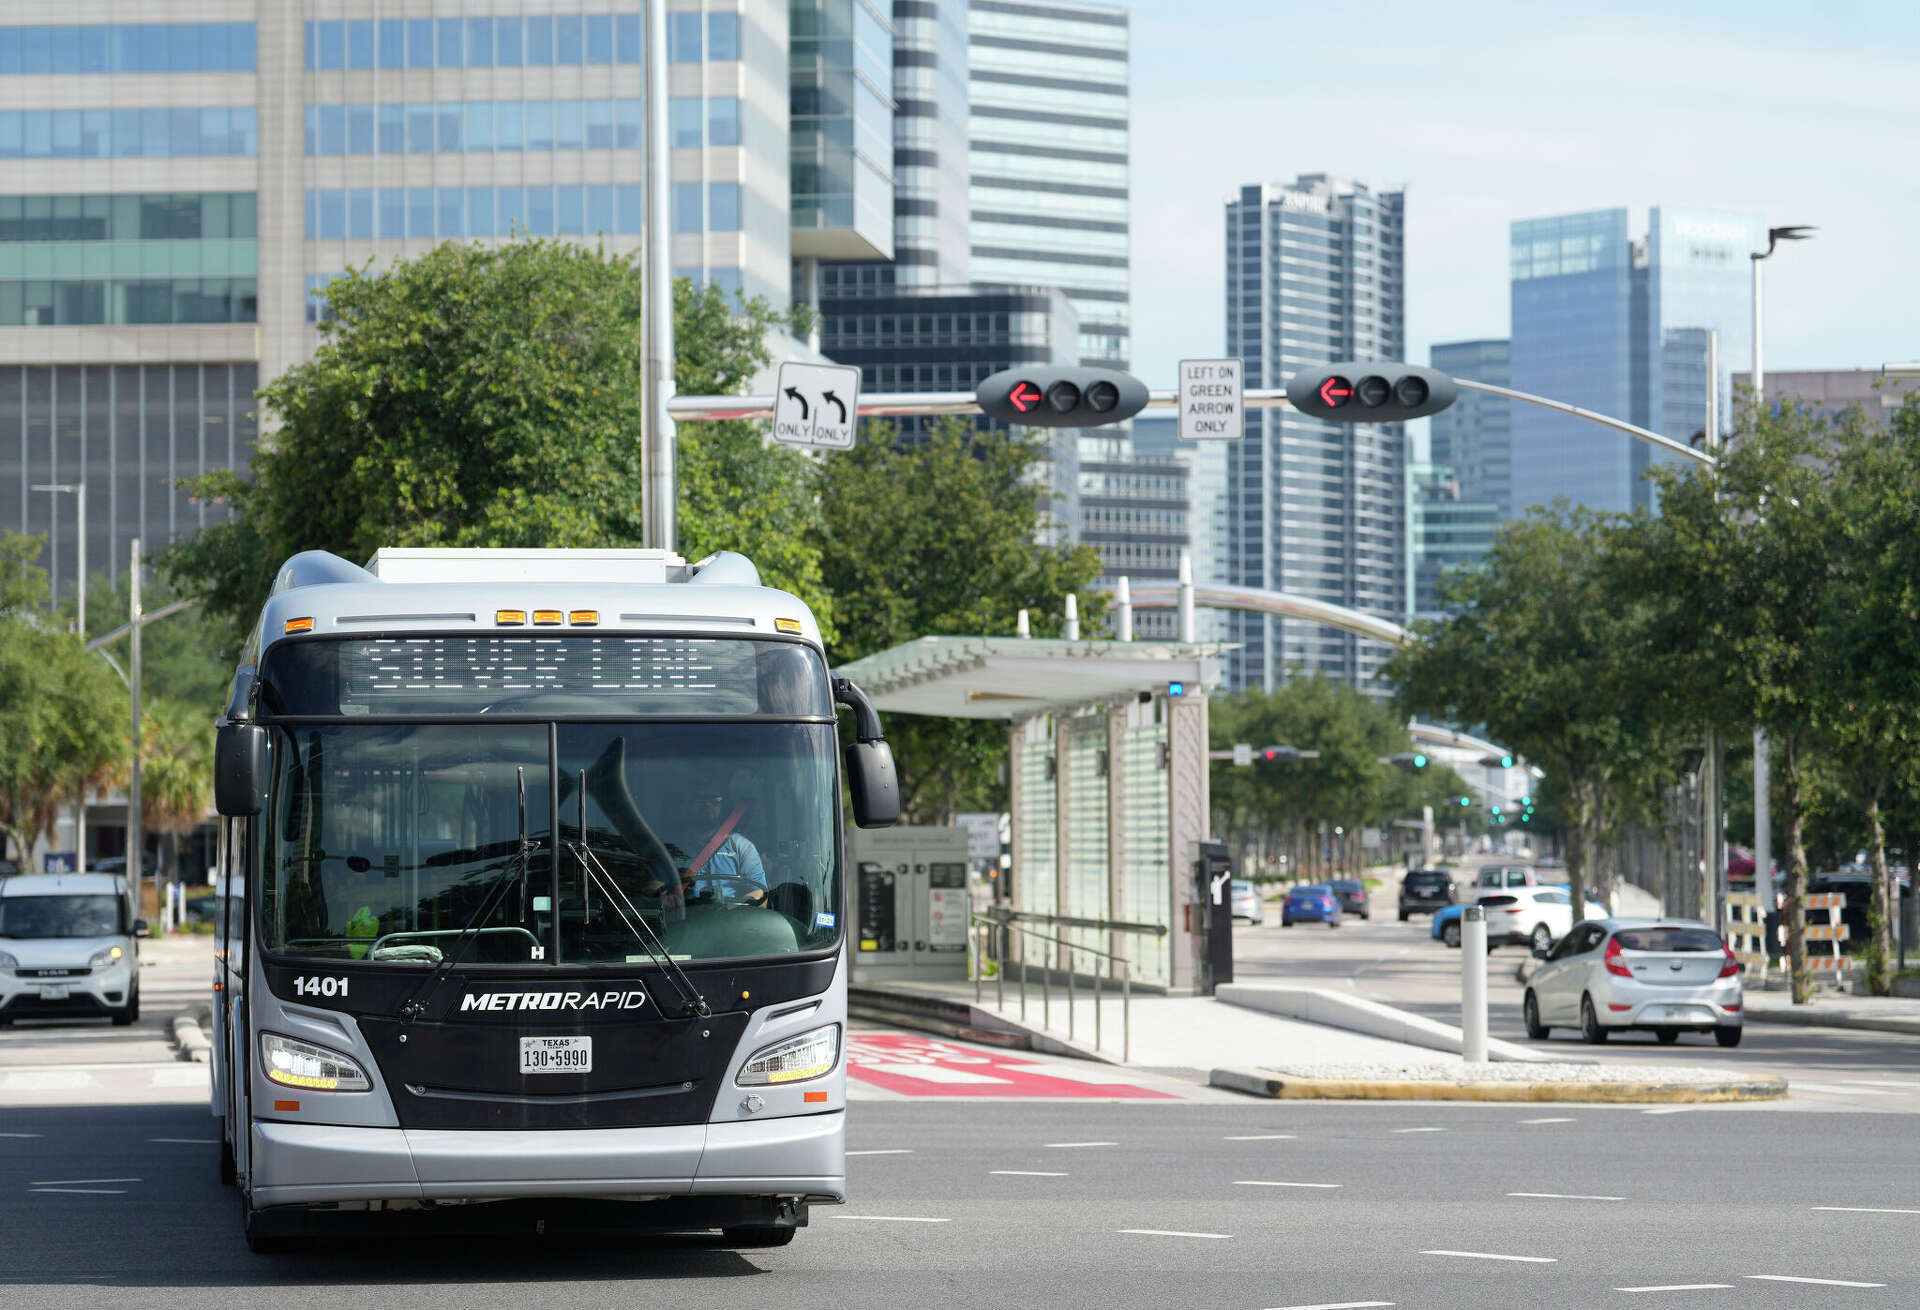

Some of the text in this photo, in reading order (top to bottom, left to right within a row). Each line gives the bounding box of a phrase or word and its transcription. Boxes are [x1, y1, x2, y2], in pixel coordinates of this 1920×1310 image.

[1188, 366, 1234, 379] LEFT ON
[1190, 384, 1233, 397] GREEN
[1188, 402, 1235, 414] ARROW
[778, 422, 810, 437] ONLY
[1194, 420, 1227, 432] ONLY
[815, 426, 849, 440] ONLY
[293, 976, 349, 997] 1401
[542, 1039, 570, 1047] TEXAS
